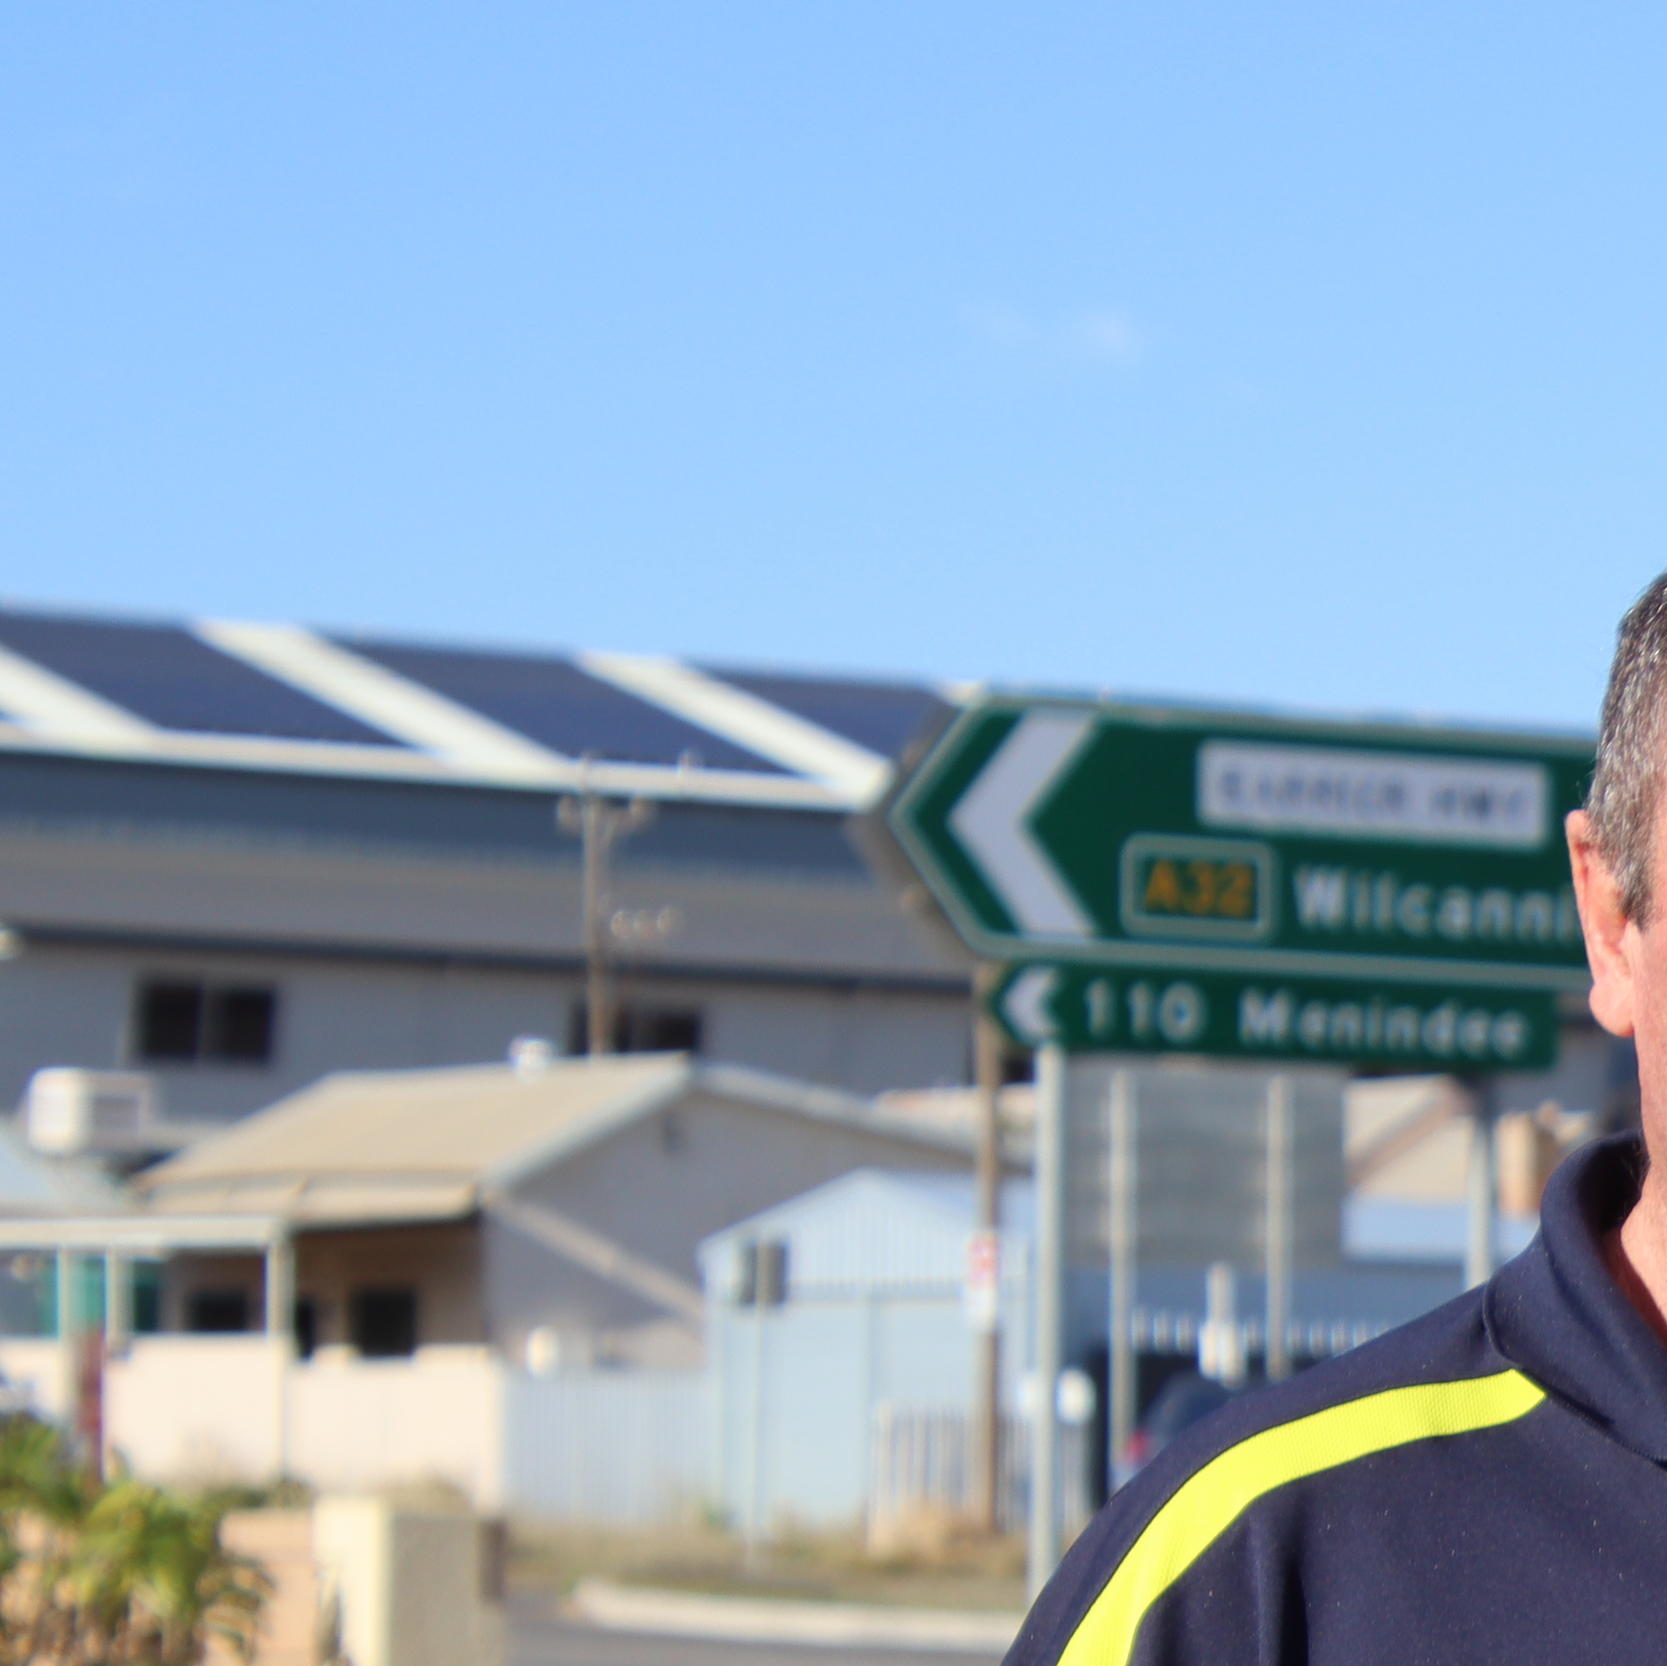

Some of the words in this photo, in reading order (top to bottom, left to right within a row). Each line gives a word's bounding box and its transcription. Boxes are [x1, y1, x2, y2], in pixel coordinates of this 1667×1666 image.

[1143, 859, 1256, 918] A32
[1295, 864, 1580, 945] Wilcanni
[1086, 980, 1206, 1046] 110
[1240, 988, 1528, 1060] Menindee
